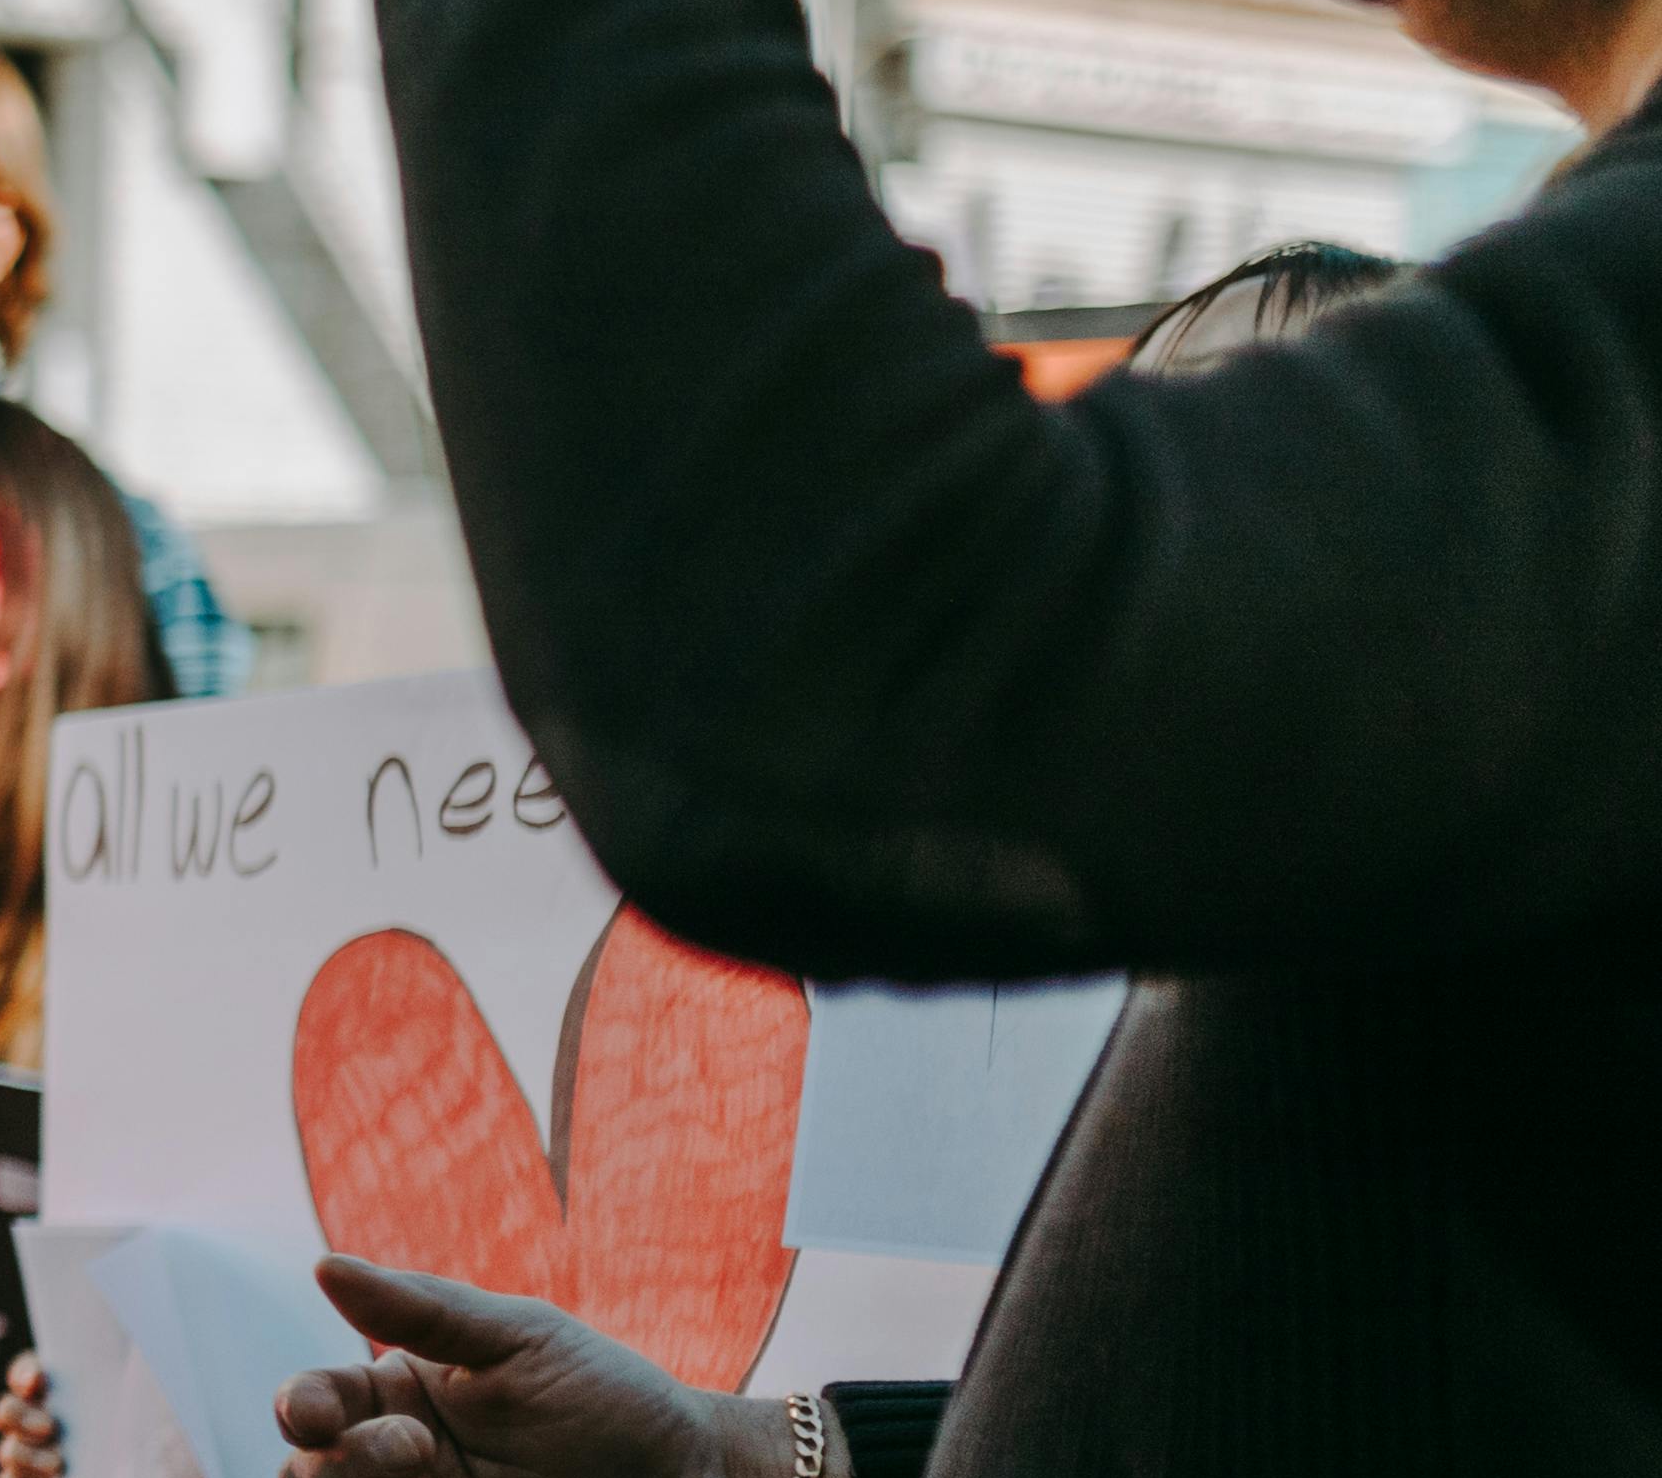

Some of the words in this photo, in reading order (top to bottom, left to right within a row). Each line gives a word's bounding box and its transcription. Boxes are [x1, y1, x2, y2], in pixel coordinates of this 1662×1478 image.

[60, 725, 146, 885] all
[170, 768, 280, 883] we
[364, 754, 568, 871] nee
